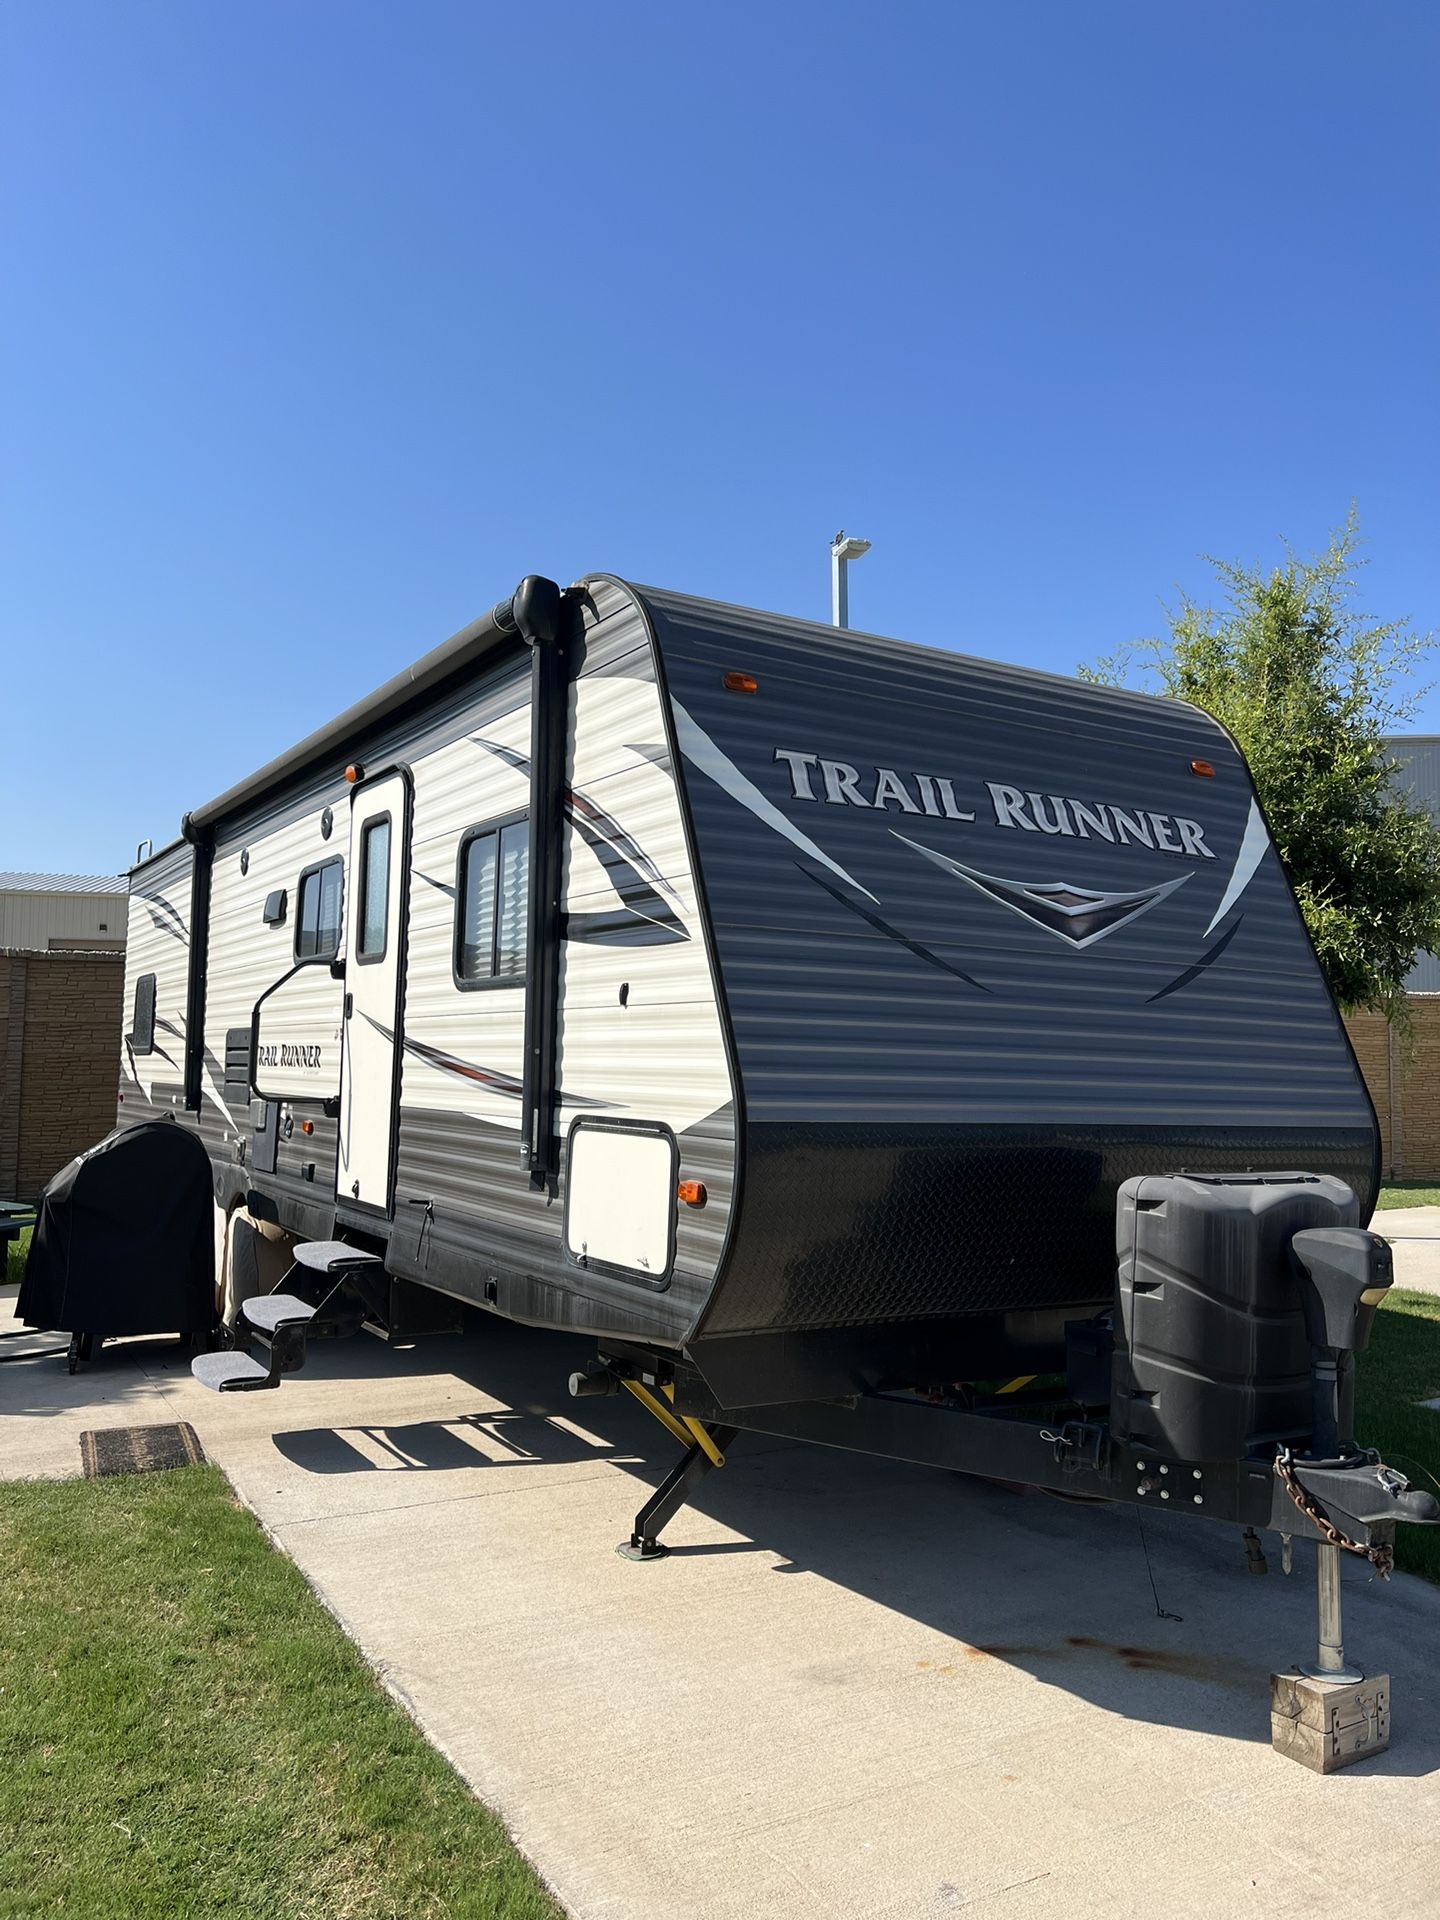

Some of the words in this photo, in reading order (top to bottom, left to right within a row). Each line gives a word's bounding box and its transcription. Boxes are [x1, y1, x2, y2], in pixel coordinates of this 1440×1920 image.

[774, 748, 976, 823] TRAIL
[983, 780, 1219, 860] RUNNER
[258, 1046, 278, 1067] RAIL
[280, 1044, 321, 1068] RUNNER
